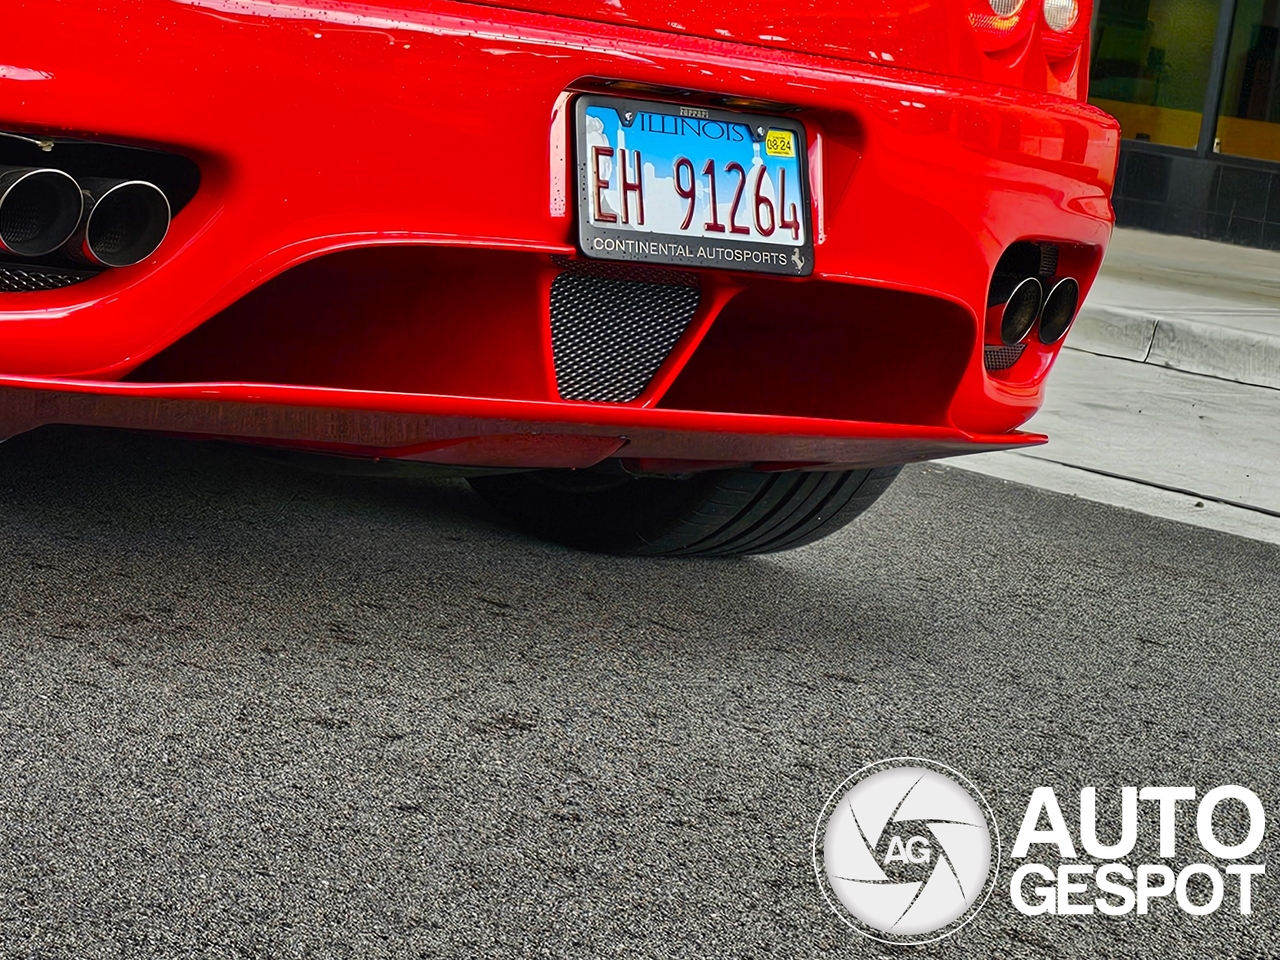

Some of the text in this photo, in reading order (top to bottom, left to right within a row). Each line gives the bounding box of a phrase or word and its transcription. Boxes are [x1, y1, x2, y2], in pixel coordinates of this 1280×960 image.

[640, 113, 745, 143] ILLINOIS
[591, 146, 800, 240] EH 91264
[593, 237, 788, 265] CONTINENTAL AUTOSPORTS
